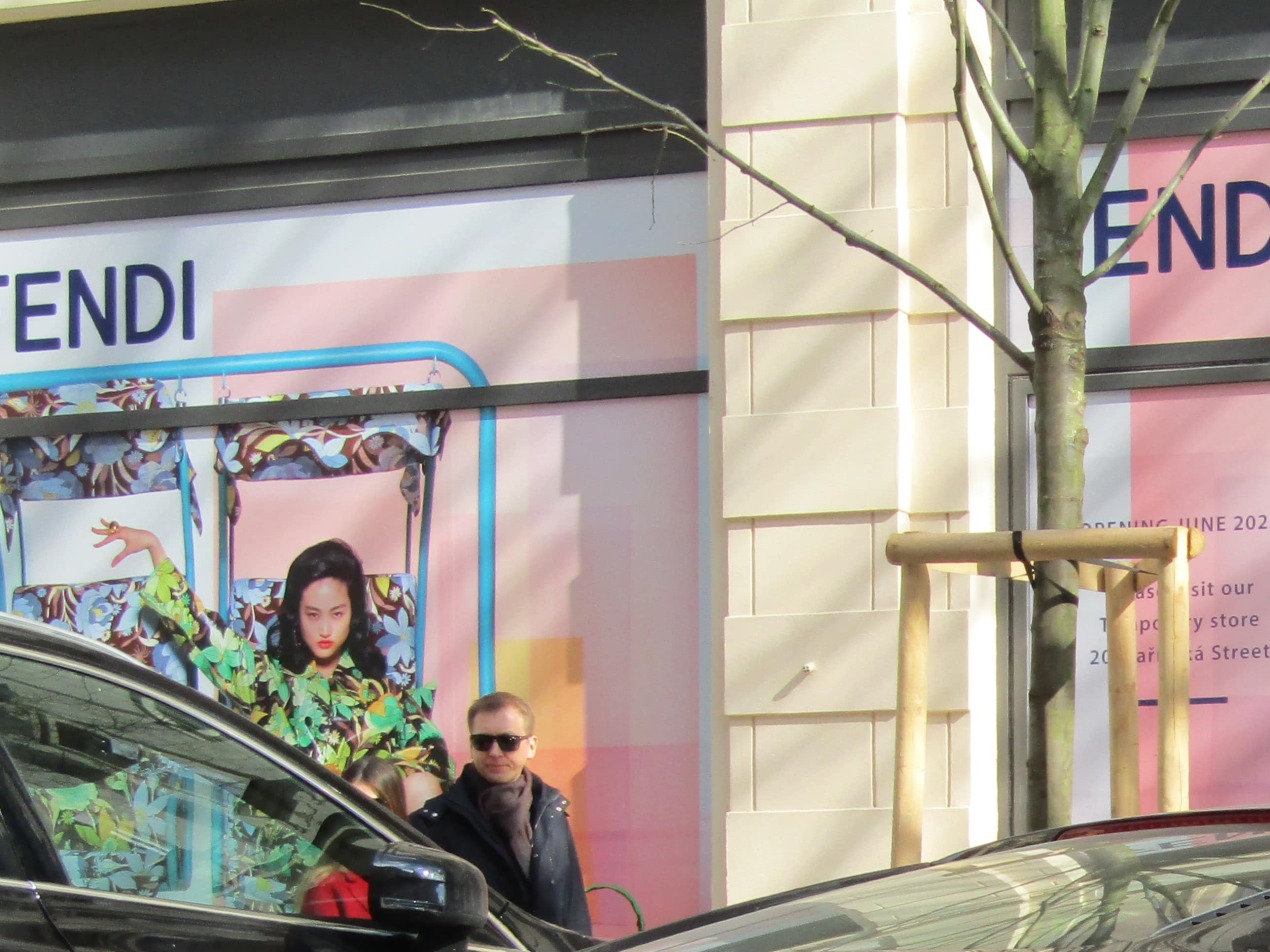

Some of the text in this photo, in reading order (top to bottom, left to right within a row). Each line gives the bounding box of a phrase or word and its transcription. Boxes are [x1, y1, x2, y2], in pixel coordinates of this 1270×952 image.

[0, 260, 196, 352] ENDI
[1191, 581, 1254, 597] sit our
[1210, 614, 1260, 628] store
[1212, 644, 1270, 660] Street
